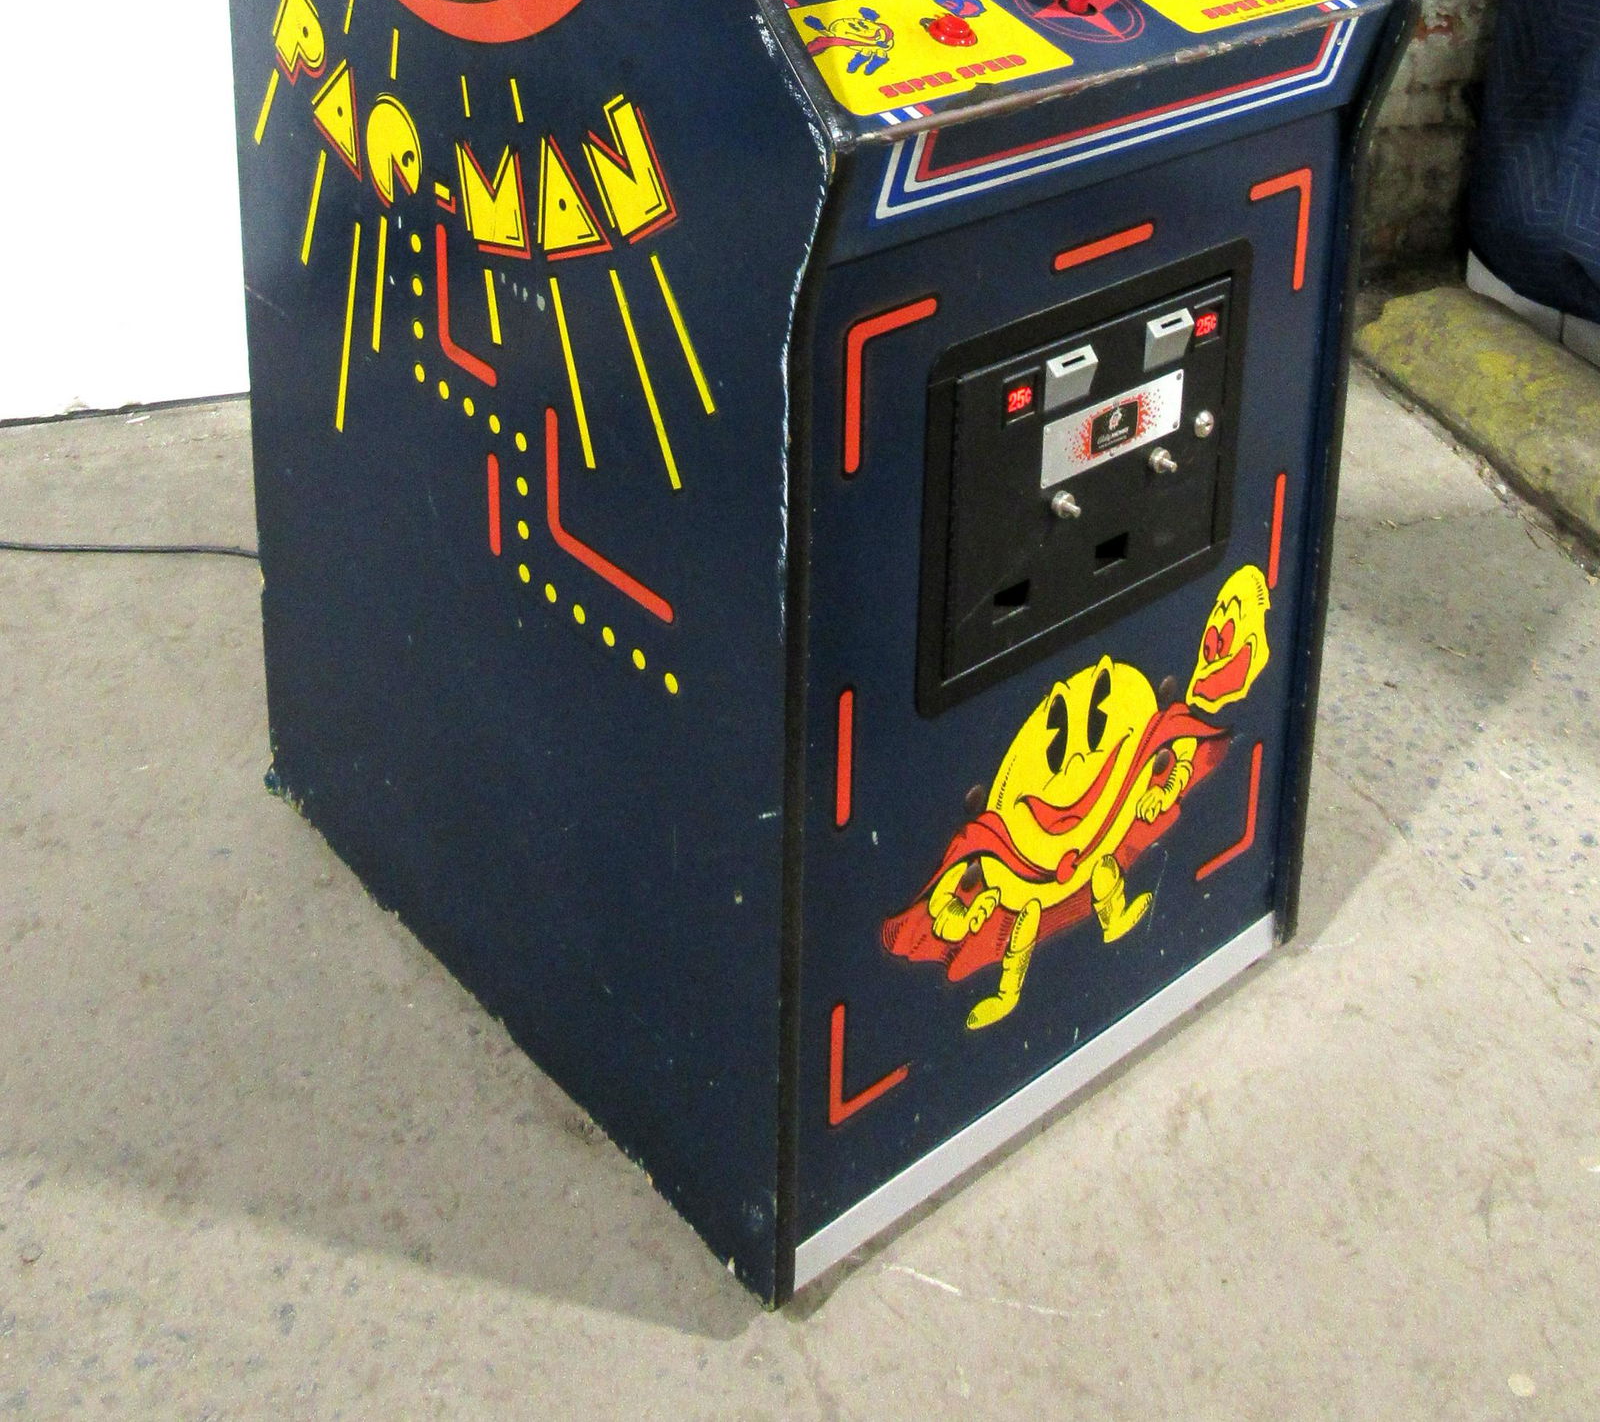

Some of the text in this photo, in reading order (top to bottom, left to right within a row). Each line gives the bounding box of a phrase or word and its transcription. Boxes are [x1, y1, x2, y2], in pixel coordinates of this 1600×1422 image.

[878, 54, 1027, 98] SUPER SPEED
[1195, 312, 1218, 338] 25¢
[1007, 386, 1033, 413] 25¢
